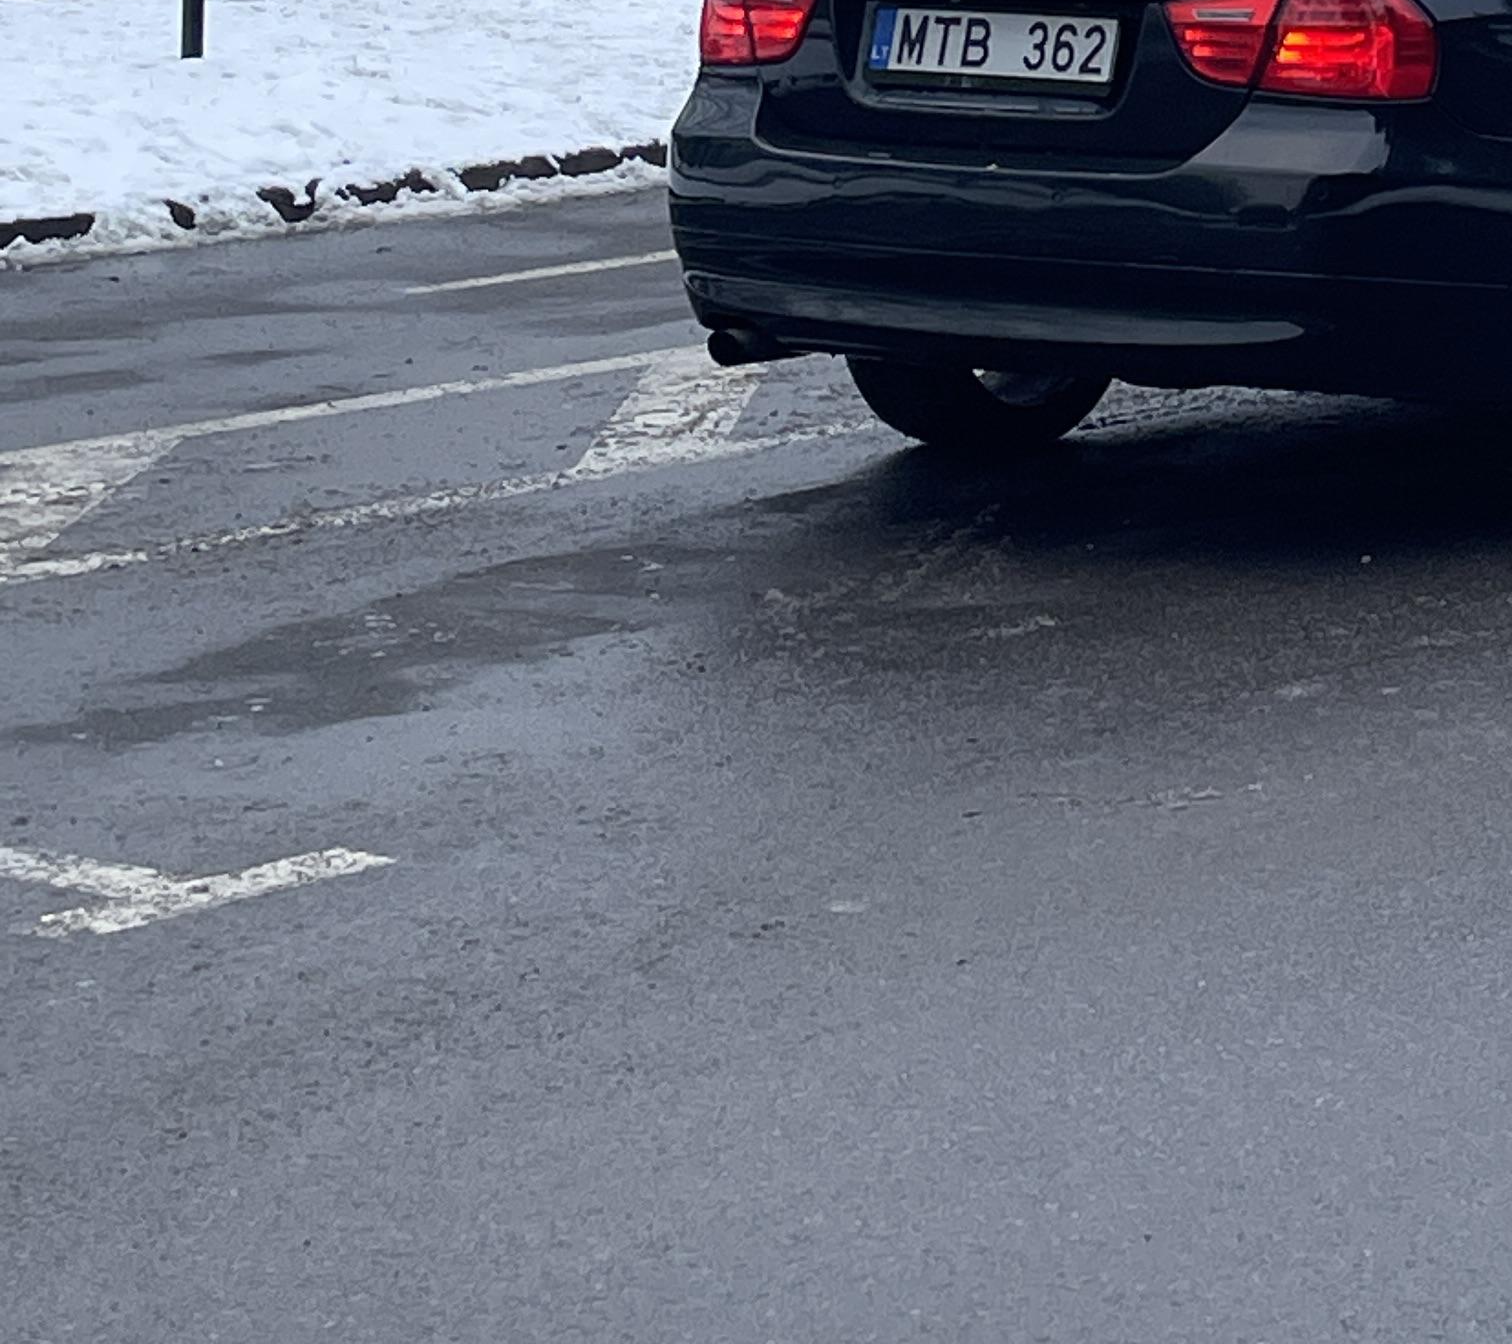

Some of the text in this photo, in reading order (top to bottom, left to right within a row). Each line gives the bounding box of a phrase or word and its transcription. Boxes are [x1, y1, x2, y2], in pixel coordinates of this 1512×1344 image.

[870, 44, 890, 60] LT
[896, 13, 1107, 75] MTB 362
